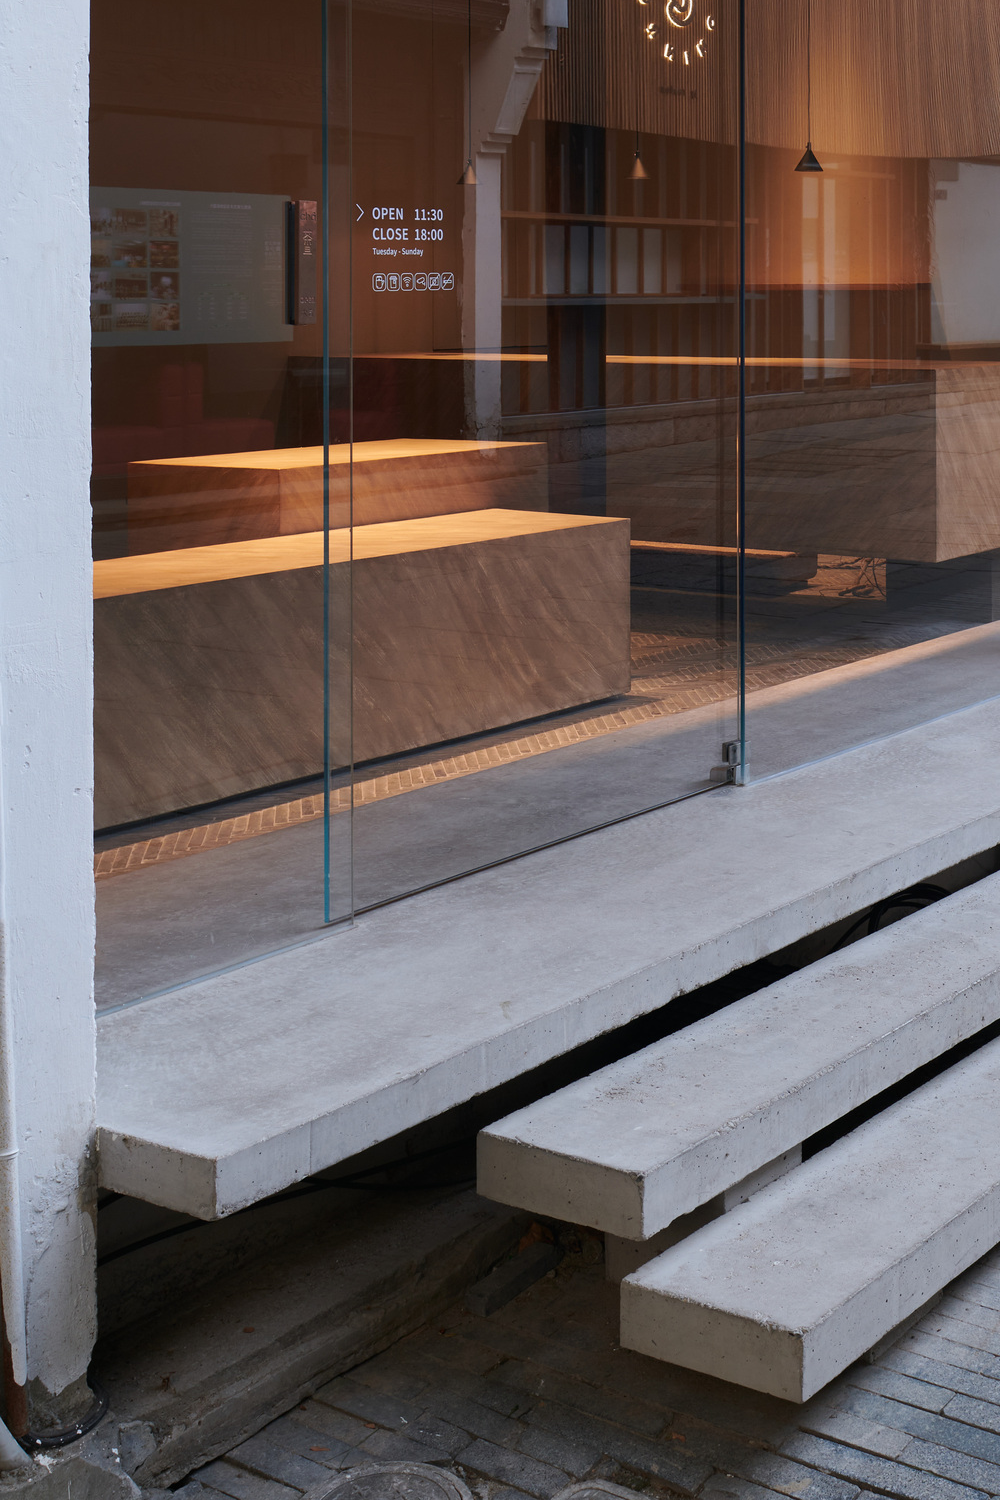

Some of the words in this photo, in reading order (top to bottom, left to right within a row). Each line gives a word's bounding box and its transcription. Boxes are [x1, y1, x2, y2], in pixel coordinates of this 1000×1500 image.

[372, 207, 404, 220] OPEN
[414, 208, 444, 221] 11:30
[372, 227, 409, 241] CLOSE
[414, 228, 444, 241] 18:00
[372, 247, 398, 257] Tuesday
[401, 247, 424, 257] Sunday
